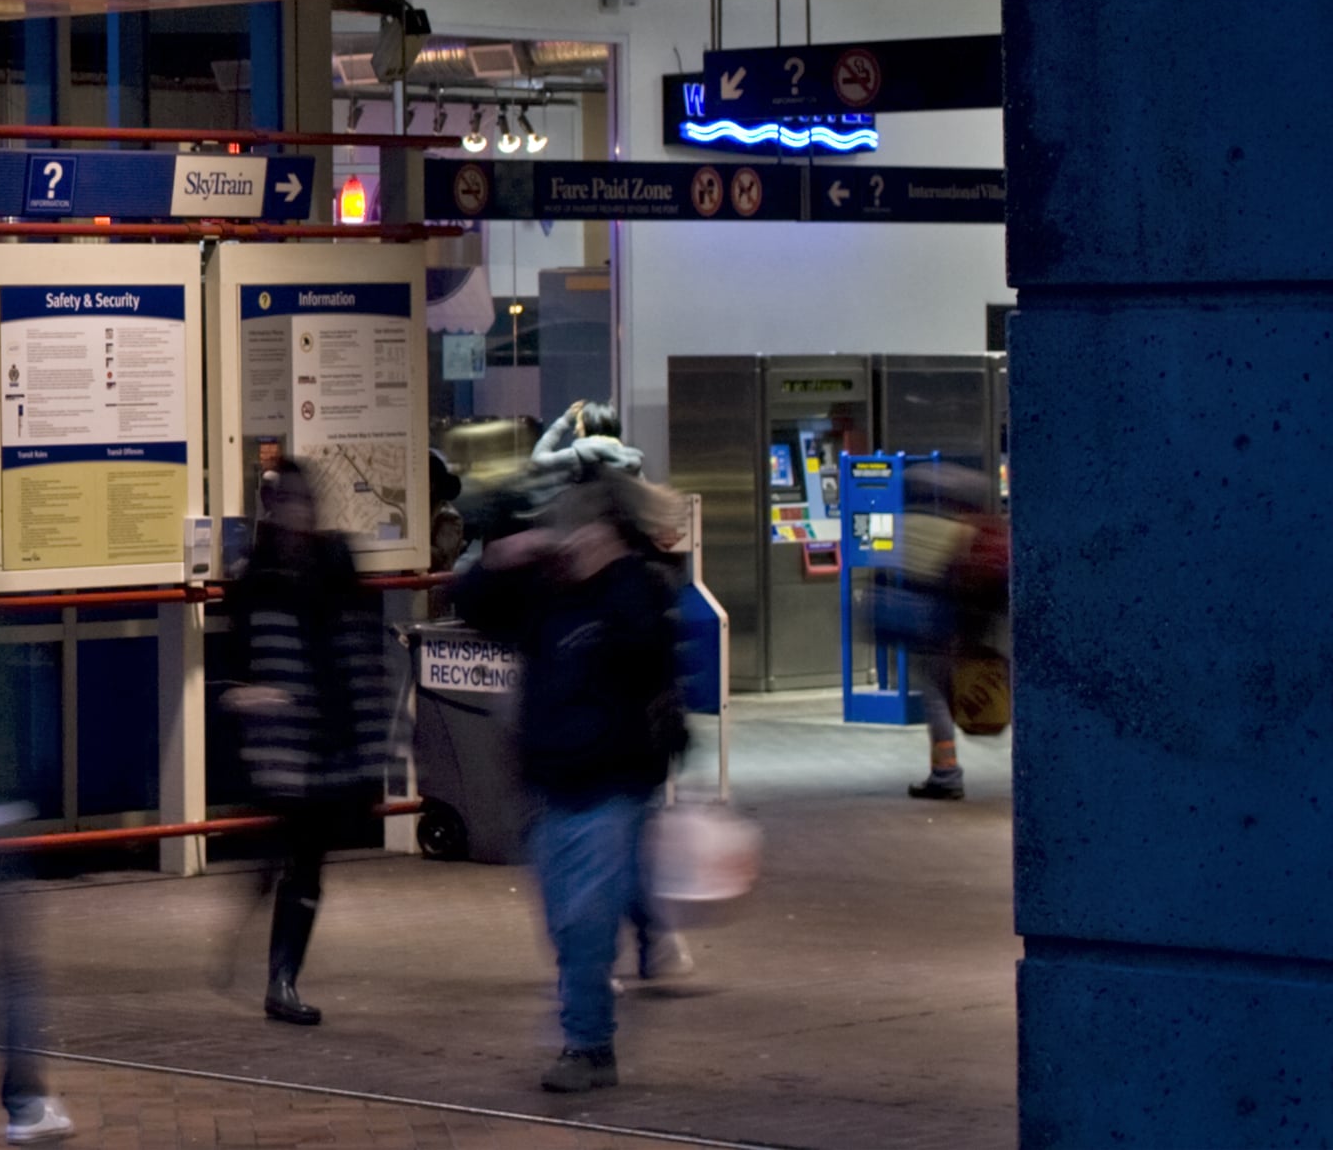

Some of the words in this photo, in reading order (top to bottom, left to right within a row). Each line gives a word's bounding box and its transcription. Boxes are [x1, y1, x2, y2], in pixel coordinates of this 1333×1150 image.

[184, 170, 254, 201] SkyTrain
[550, 177, 589, 200] Fare
[591, 177, 629, 200] Paid
[631, 177, 673, 200] Zone
[45, 292, 81, 312] Safety
[82, 293, 93, 308] &
[95, 292, 140, 312] Security
[298, 291, 356, 307] Information
